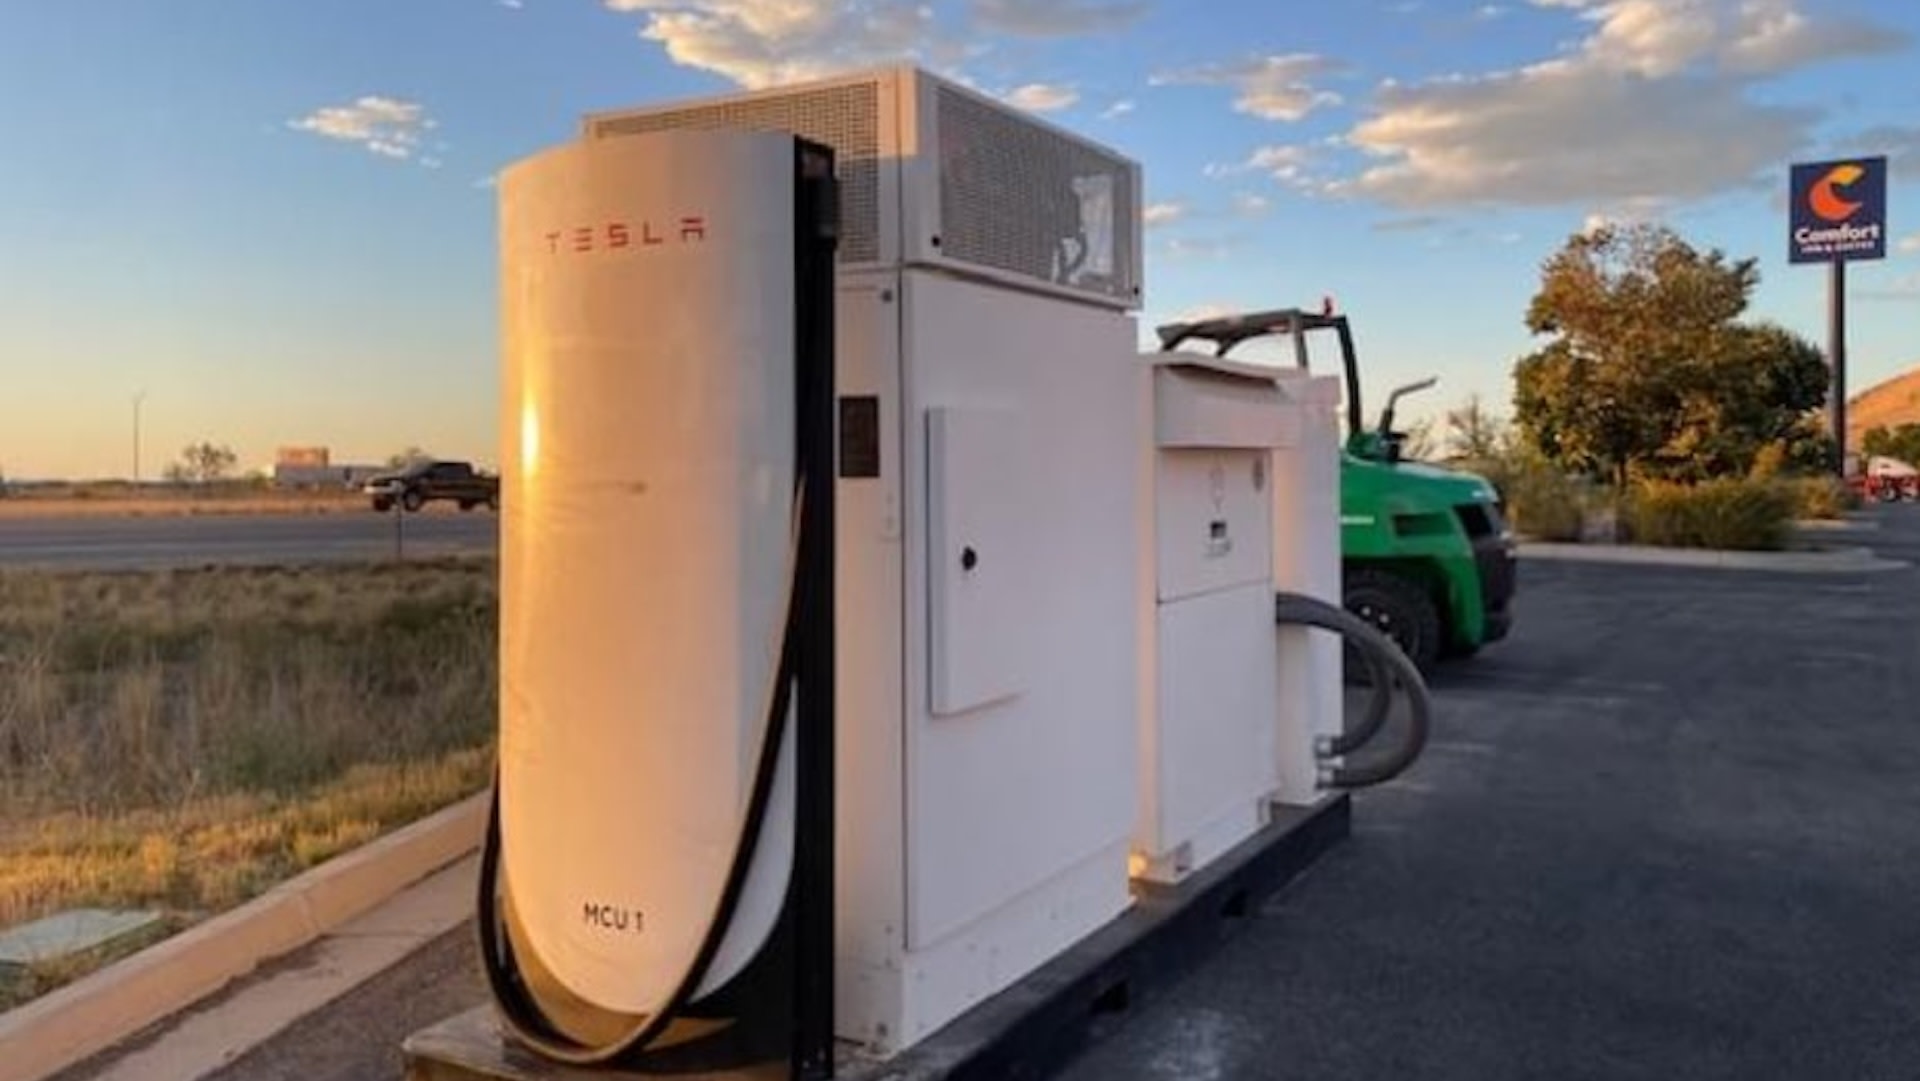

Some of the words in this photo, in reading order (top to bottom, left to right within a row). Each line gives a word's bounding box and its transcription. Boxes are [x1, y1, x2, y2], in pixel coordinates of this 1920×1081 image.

[545, 217, 704, 253] TESLA
[1794, 223, 1880, 244] Comfort
[584, 902, 629, 930] MCU
[636, 911, 644, 932] 1
